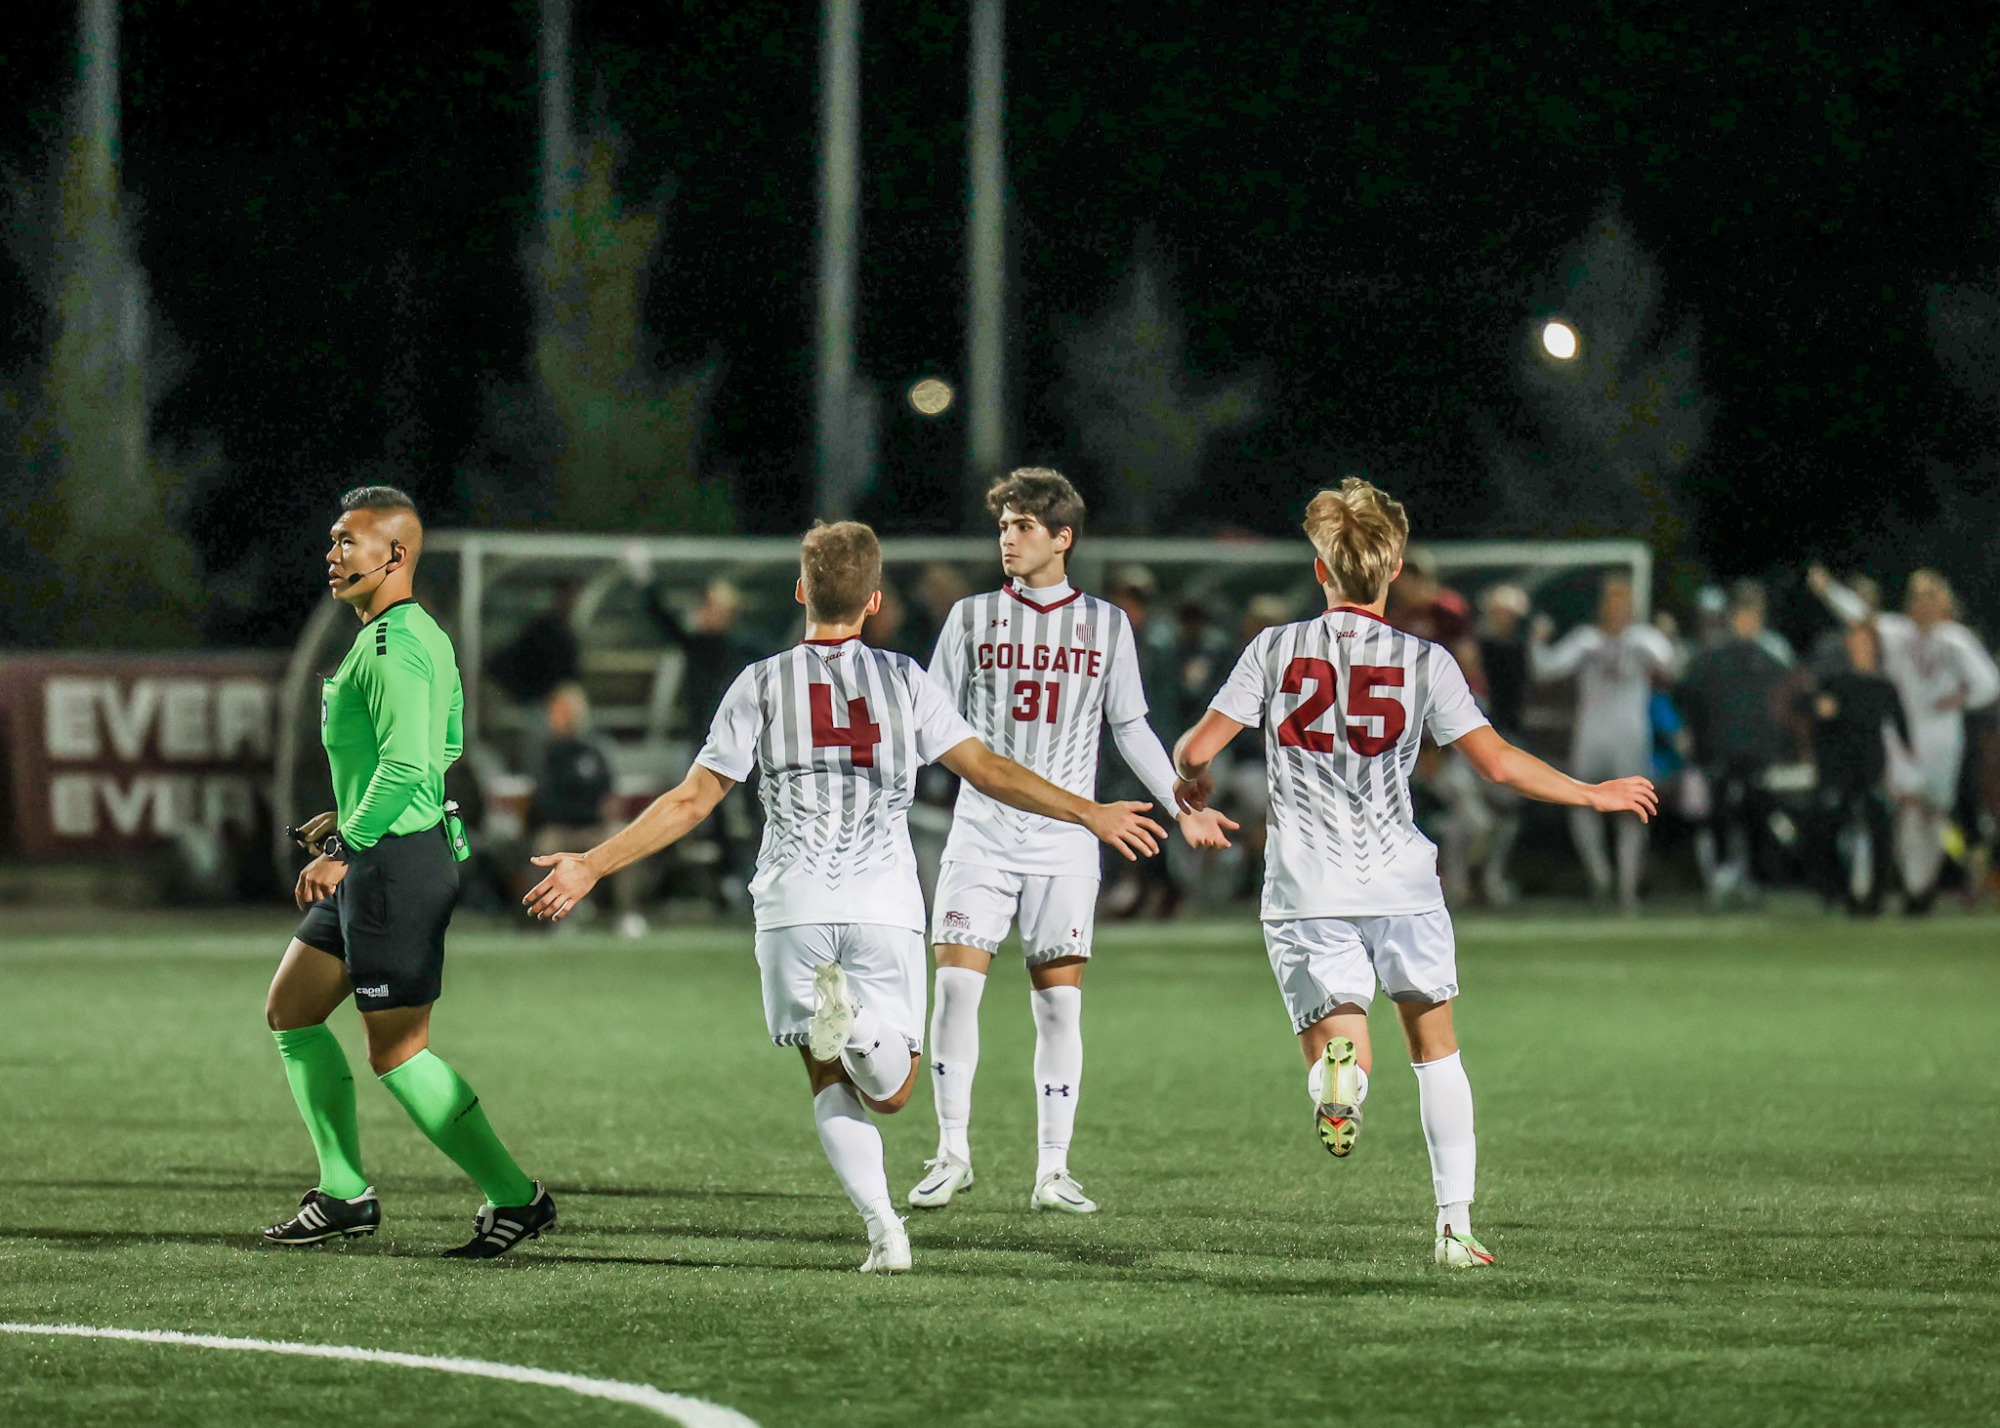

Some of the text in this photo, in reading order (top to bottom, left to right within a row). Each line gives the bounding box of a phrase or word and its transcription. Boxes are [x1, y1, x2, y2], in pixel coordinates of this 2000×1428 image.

[978, 643, 1101, 678] COLGATE
[1012, 680, 1060, 724] 31
[1278, 657, 1406, 757] 25
[809, 683, 881, 768] 4
[356, 983, 389, 997] capelli
